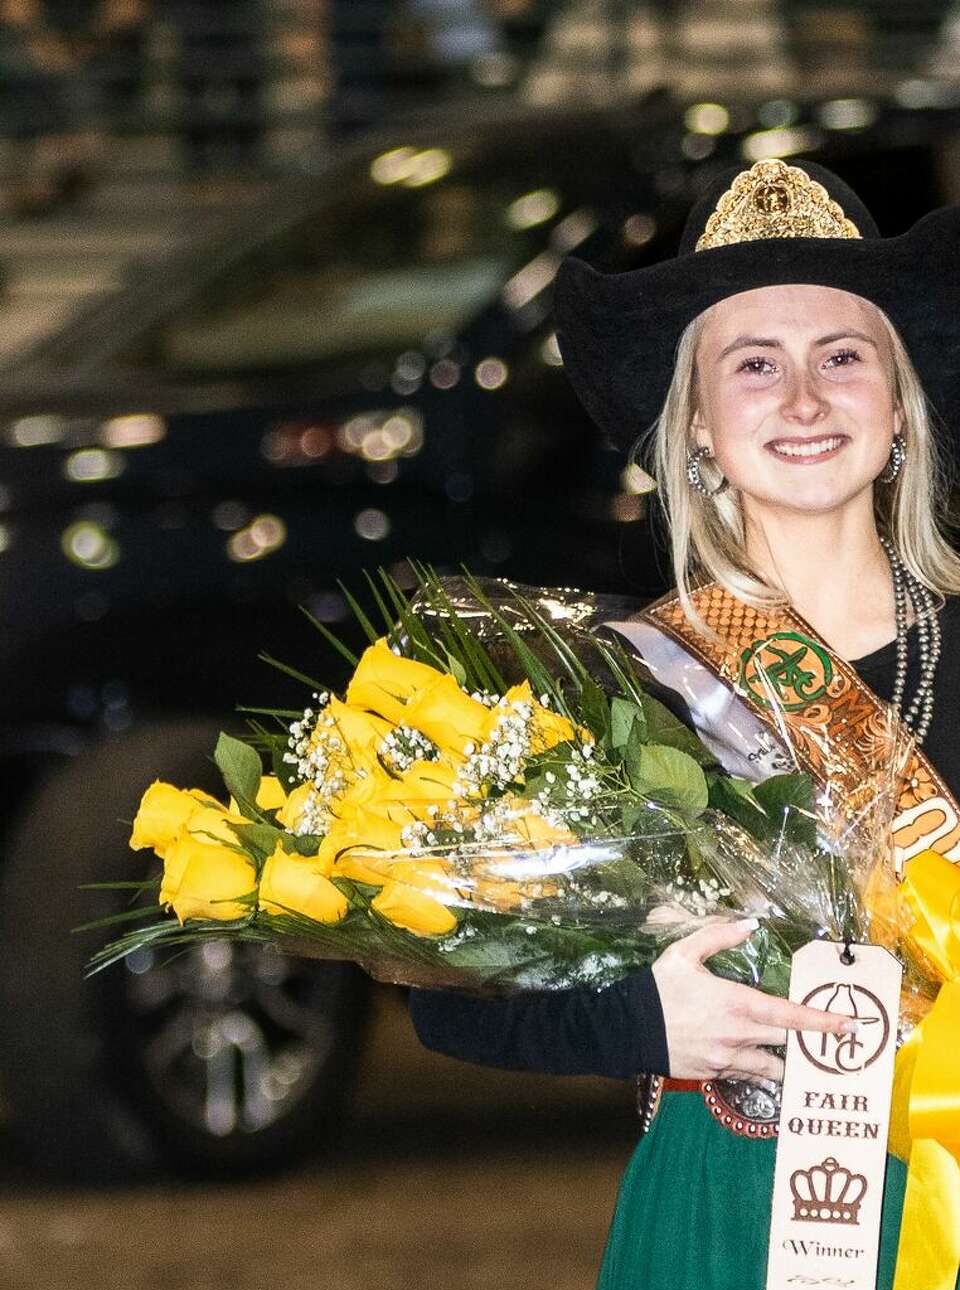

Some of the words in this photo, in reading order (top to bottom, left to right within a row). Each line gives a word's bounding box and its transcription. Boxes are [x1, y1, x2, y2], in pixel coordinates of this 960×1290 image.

[803, 1091, 869, 1113] FAIR
[787, 1116, 880, 1140] QUEEN
[782, 1238, 865, 1260] Winner
